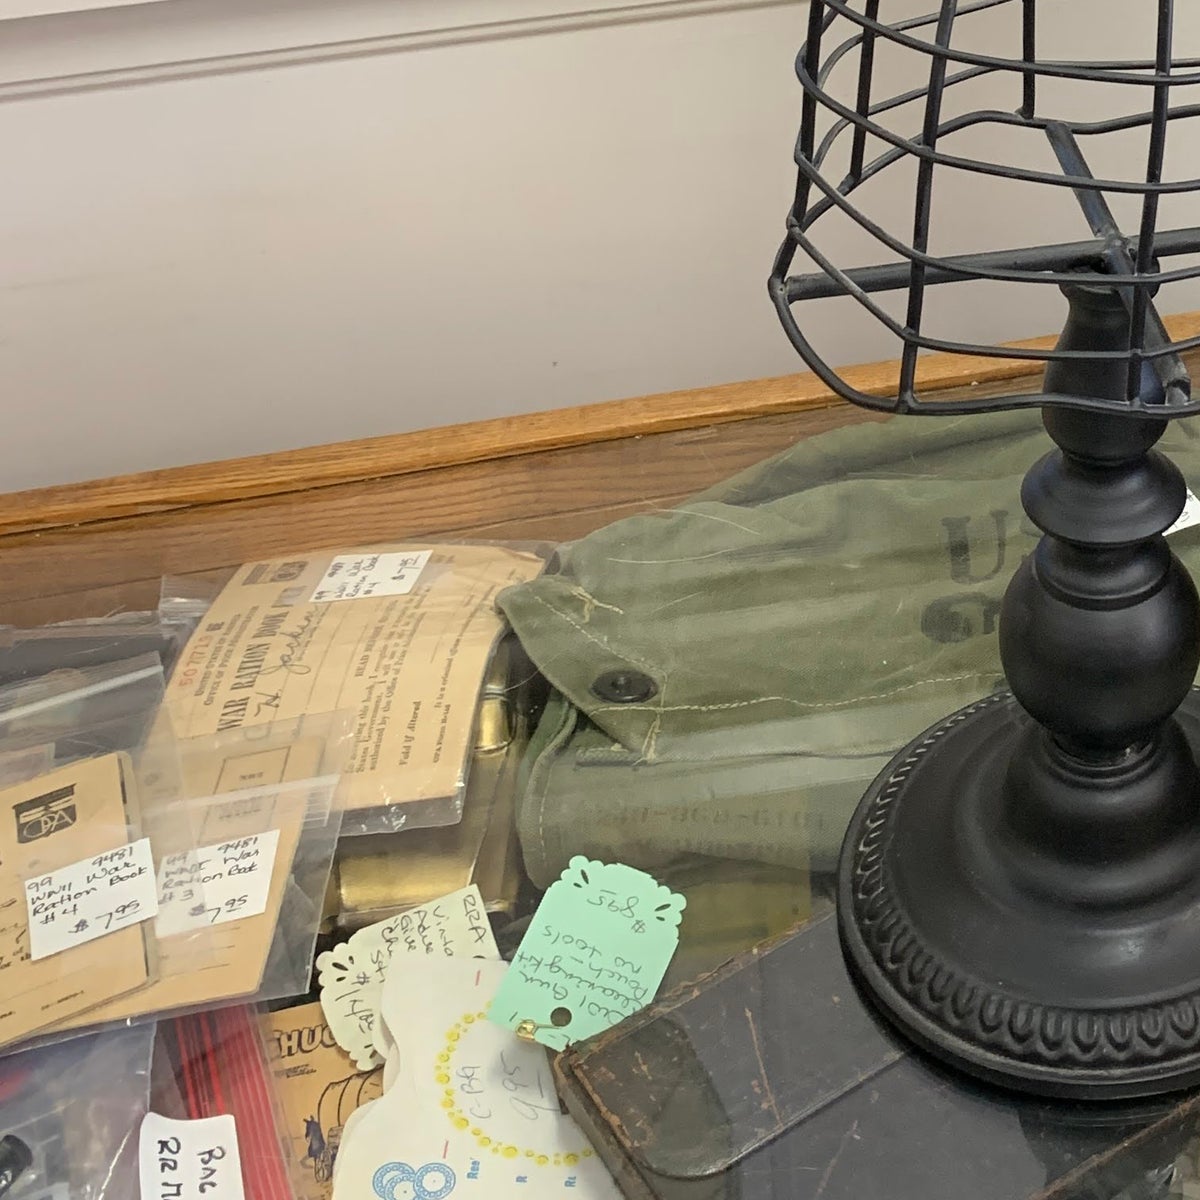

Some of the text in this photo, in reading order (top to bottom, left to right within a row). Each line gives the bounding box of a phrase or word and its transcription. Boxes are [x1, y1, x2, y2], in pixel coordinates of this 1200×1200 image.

[251, 611, 290, 639] BOOK
[230, 642, 272, 691] RATION
[216, 696, 251, 732] WAR
[86, 859, 137, 885] War
[223, 848, 260, 865] War
[32, 866, 149, 918] Ration Book
[161, 861, 259, 891] Ration Book
[542, 925, 603, 959] tools
[518, 970, 569, 1001] Gun
[588, 962, 650, 1000] Pouch
